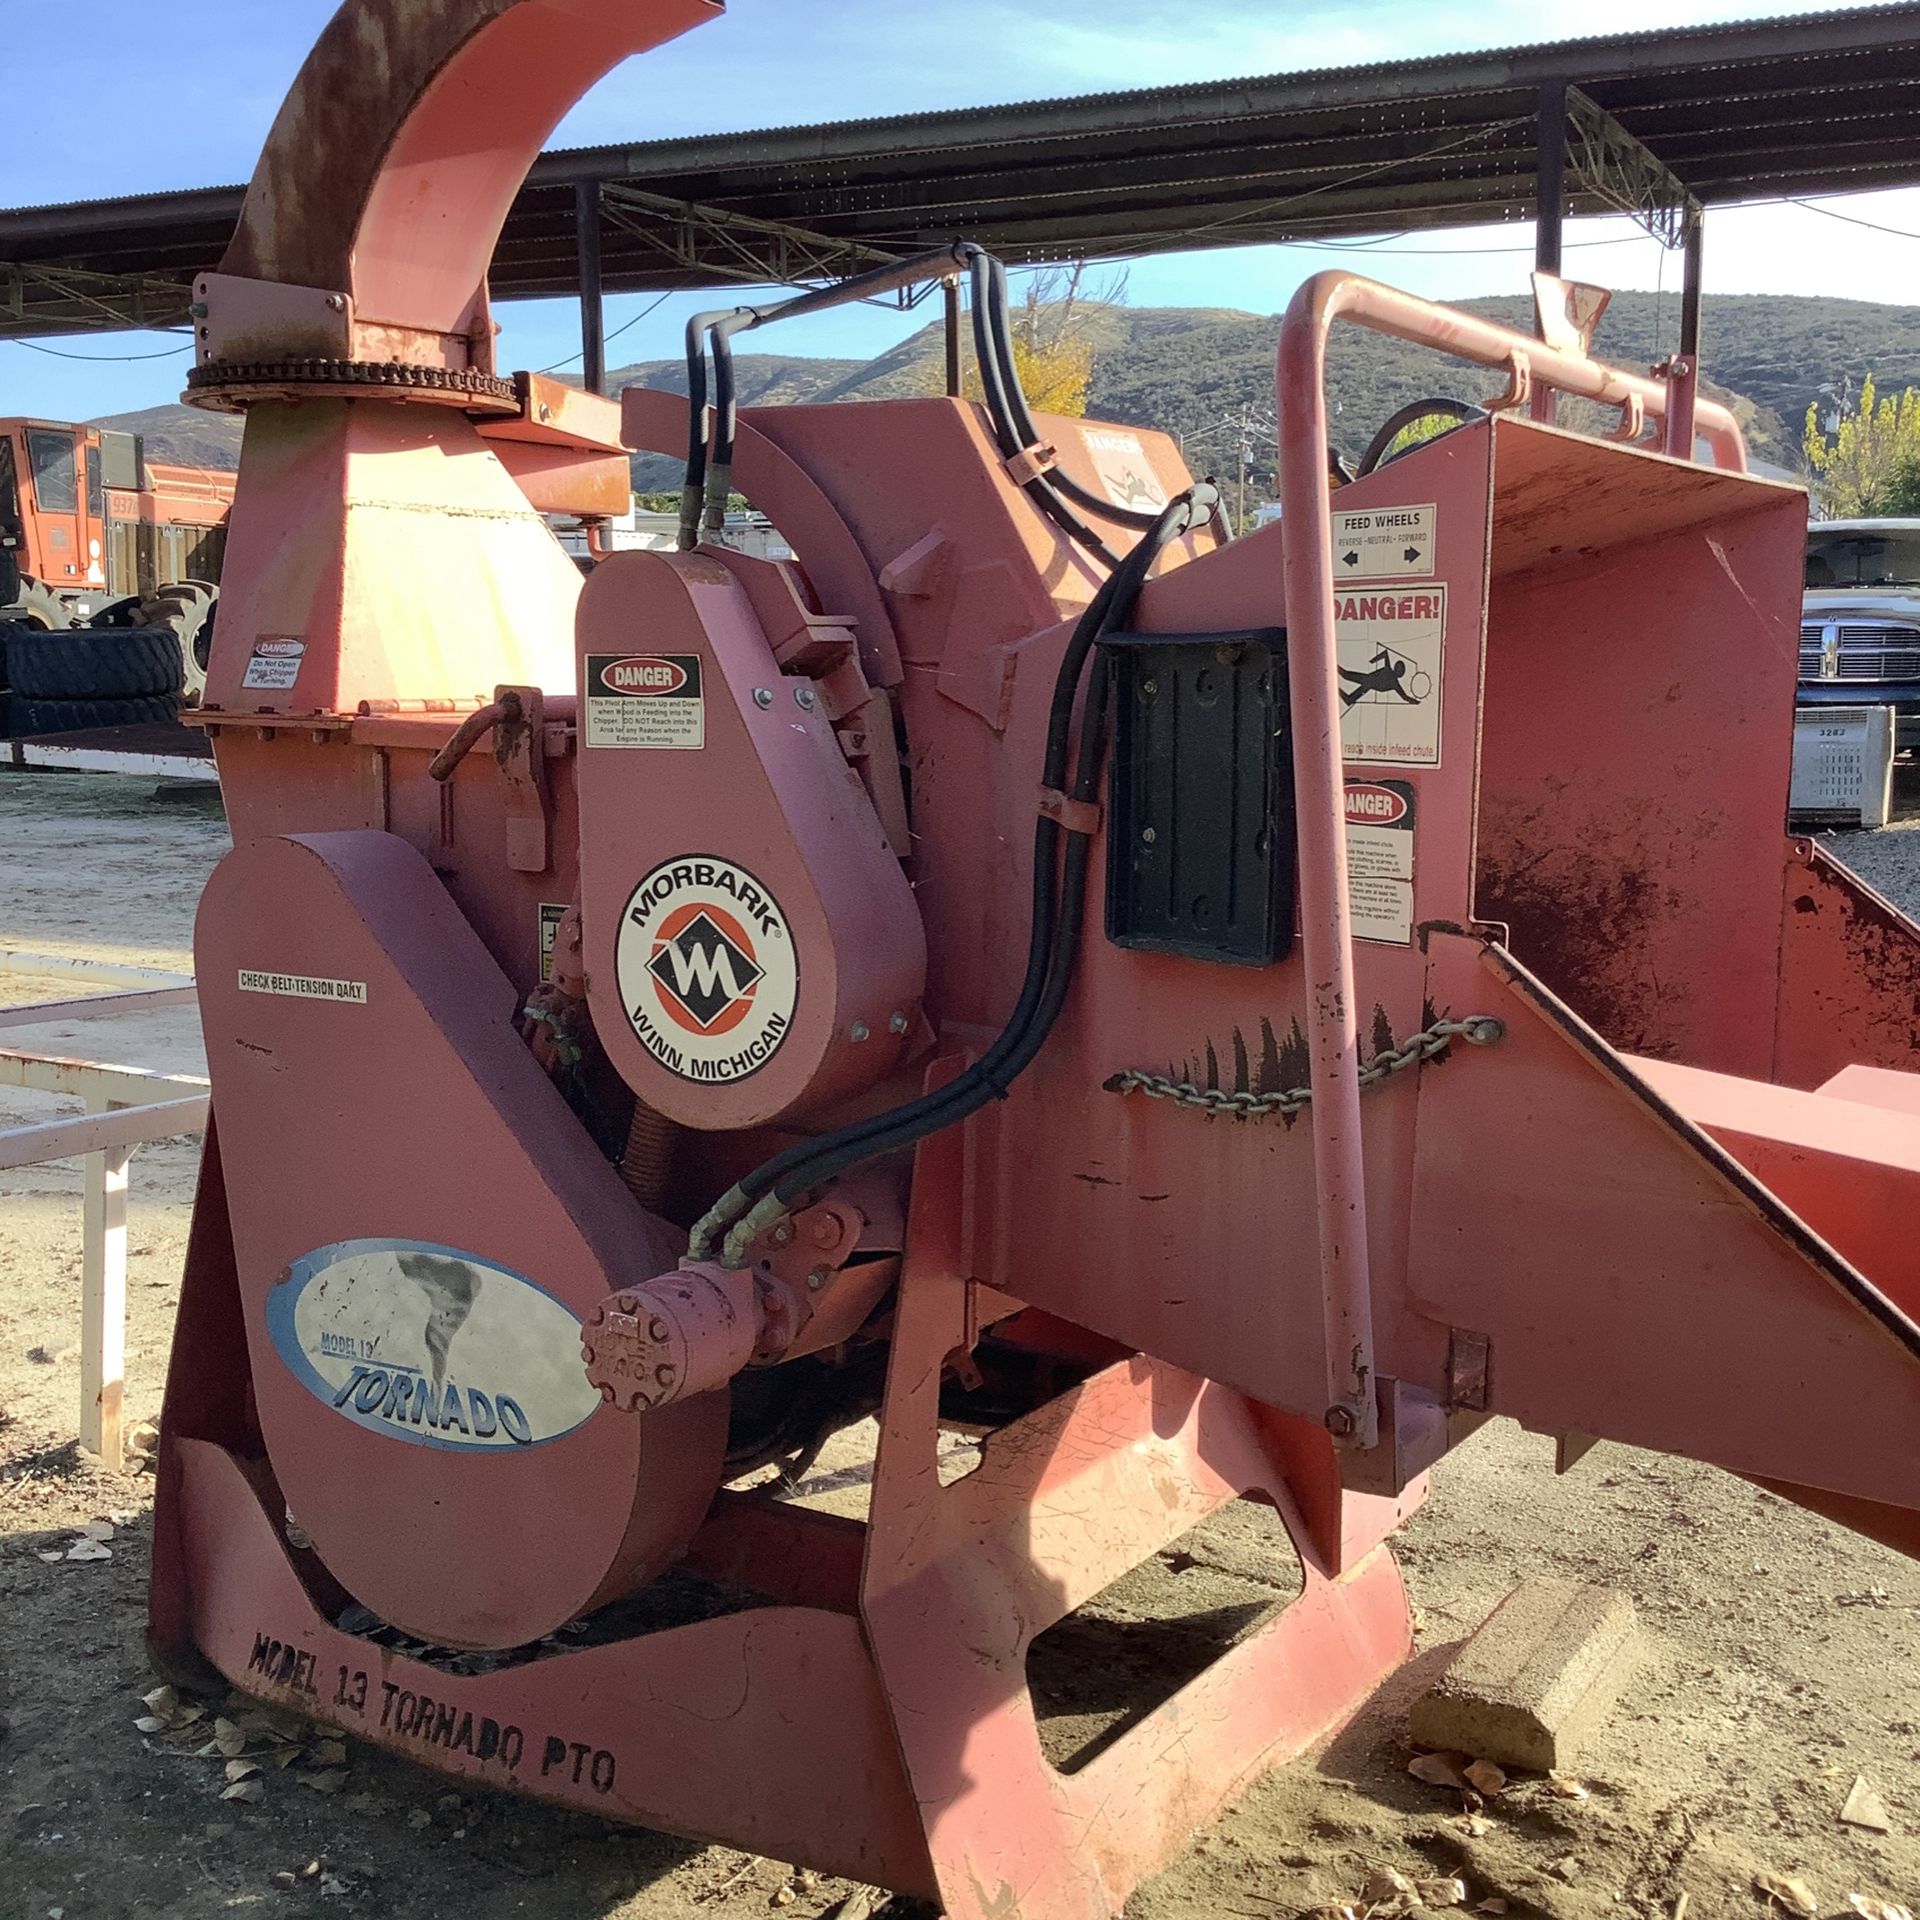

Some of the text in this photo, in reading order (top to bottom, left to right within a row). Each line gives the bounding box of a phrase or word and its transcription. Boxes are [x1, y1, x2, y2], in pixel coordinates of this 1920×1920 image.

[1344, 513, 1420, 530] FEED WHEELS
[269, 669, 295, 677] Chipper
[278, 660, 296, 668] Open
[614, 667, 673, 686] DANGER
[642, 709, 668, 717] Feeding
[1344, 793, 1393, 817] ANGER
[630, 864, 781, 937] MORBARK
[241, 972, 270, 989] CHECK
[632, 1005, 787, 1079] WINN, MICHIGAN
[321, 1331, 357, 1356] MODEL
[332, 1365, 533, 1446] TORNADO
[247, 1631, 617, 1796] MODEL 13 TORNADO PTO
